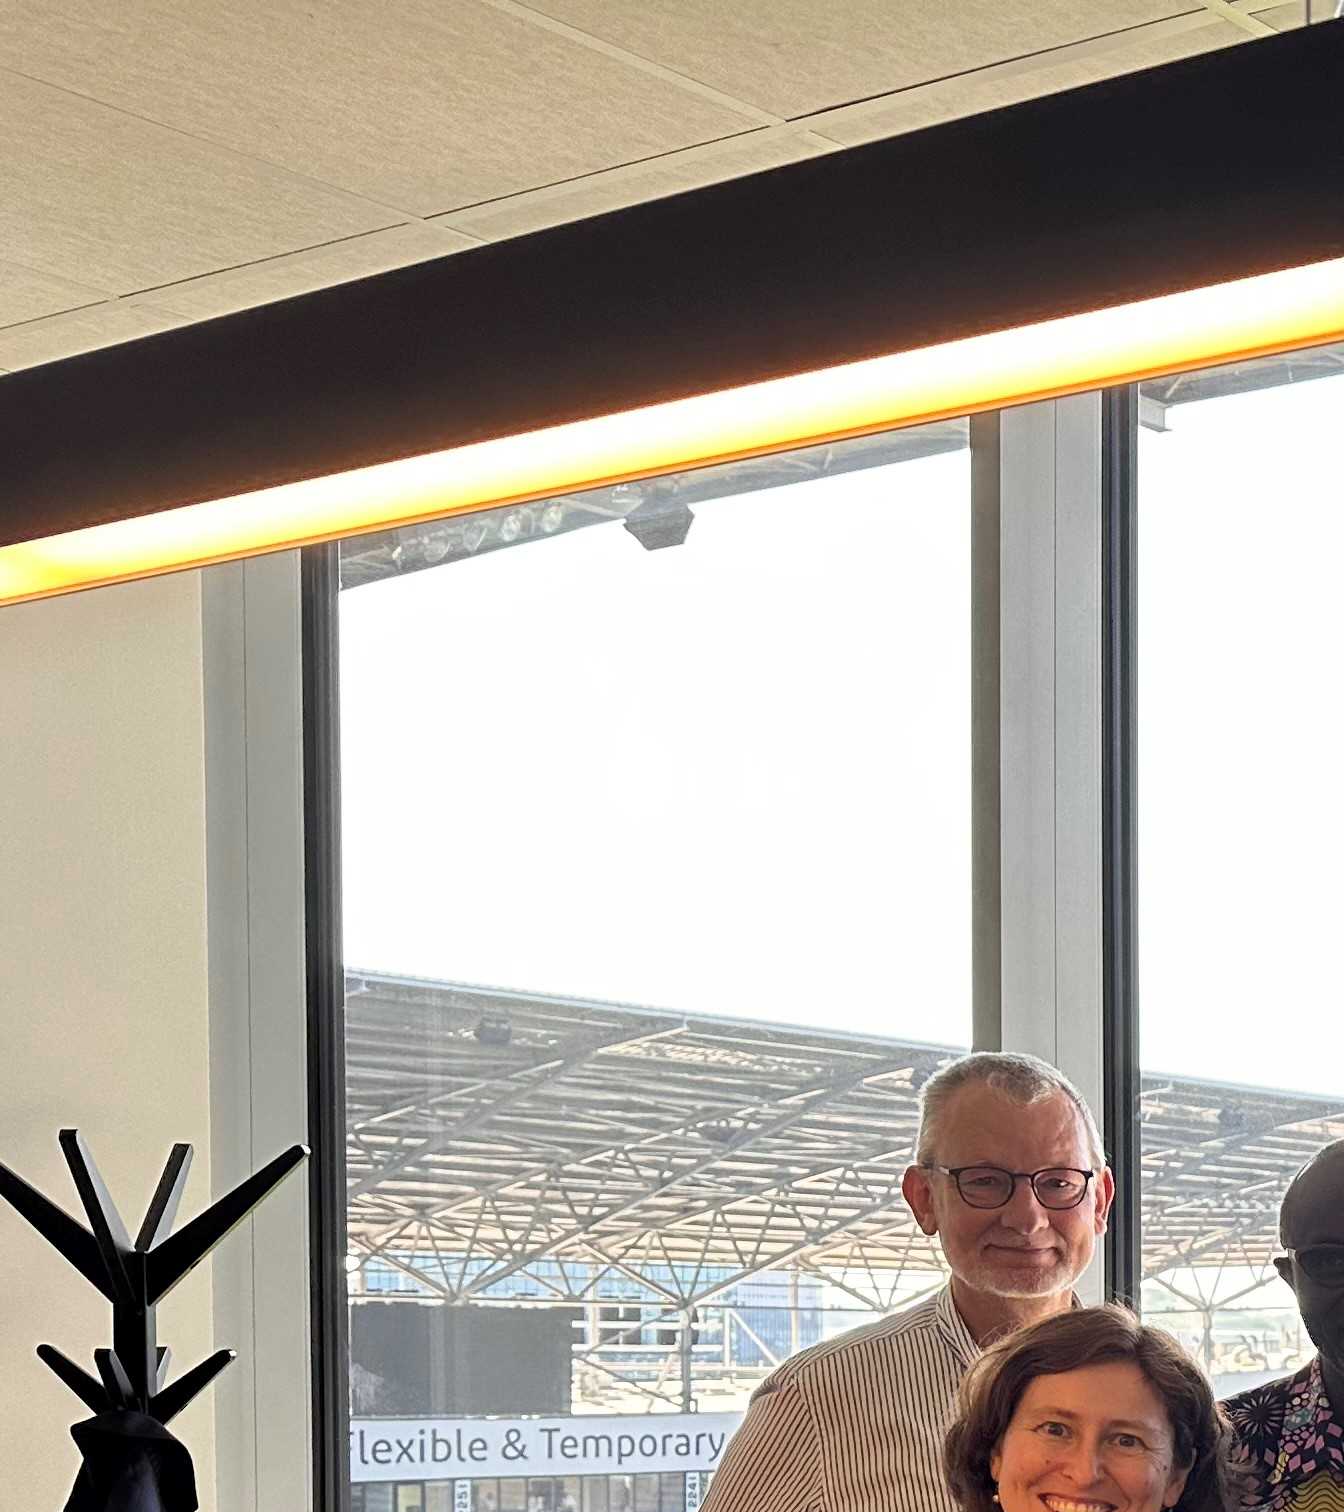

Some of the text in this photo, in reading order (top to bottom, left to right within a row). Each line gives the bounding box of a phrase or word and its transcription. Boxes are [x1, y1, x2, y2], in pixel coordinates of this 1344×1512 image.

[348, 1427, 726, 1465] lexible & Temporary
